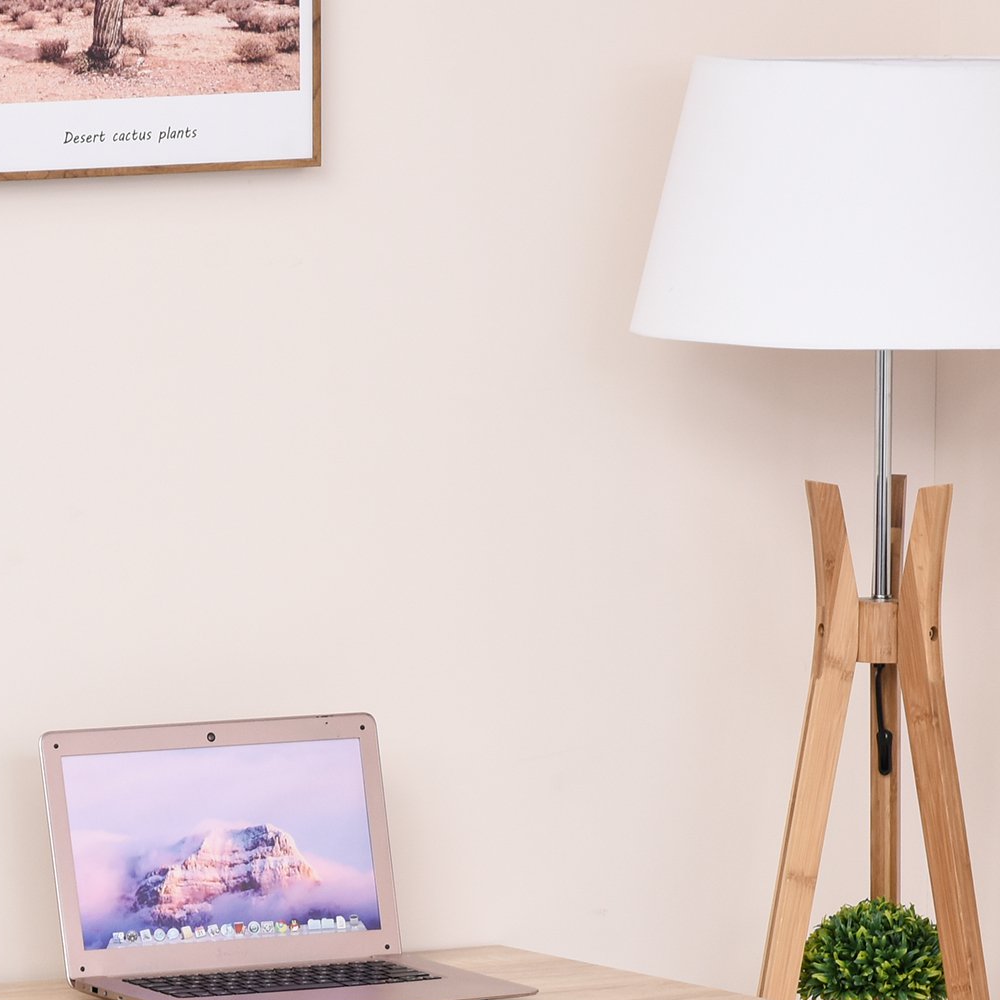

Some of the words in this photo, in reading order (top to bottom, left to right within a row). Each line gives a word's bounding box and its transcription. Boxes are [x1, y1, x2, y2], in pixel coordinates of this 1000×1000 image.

[63, 130, 106, 145] Desert
[112, 129, 152, 142] cactus
[158, 126, 197, 144] plants
